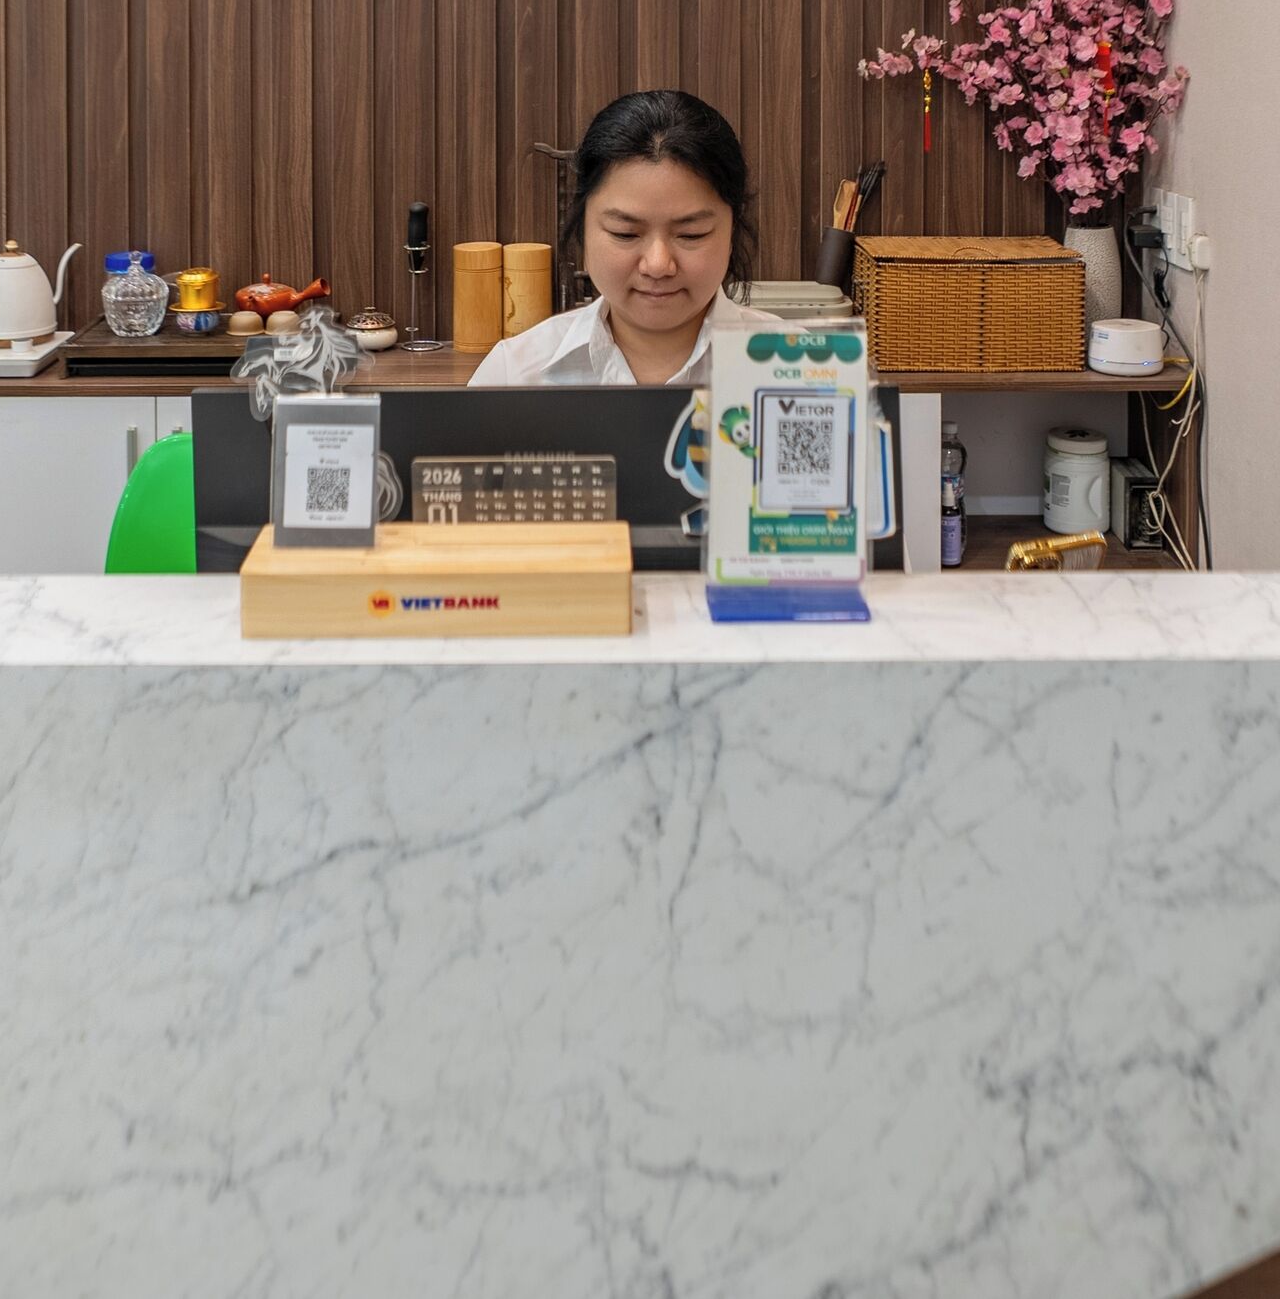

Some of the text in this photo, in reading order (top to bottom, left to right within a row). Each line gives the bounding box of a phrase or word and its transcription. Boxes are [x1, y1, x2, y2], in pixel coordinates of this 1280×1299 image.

[799, 335, 827, 347] OCB
[773, 368, 802, 380] OCB
[422, 467, 462, 486] 2026
[401, 596, 500, 611] VIETBANK
